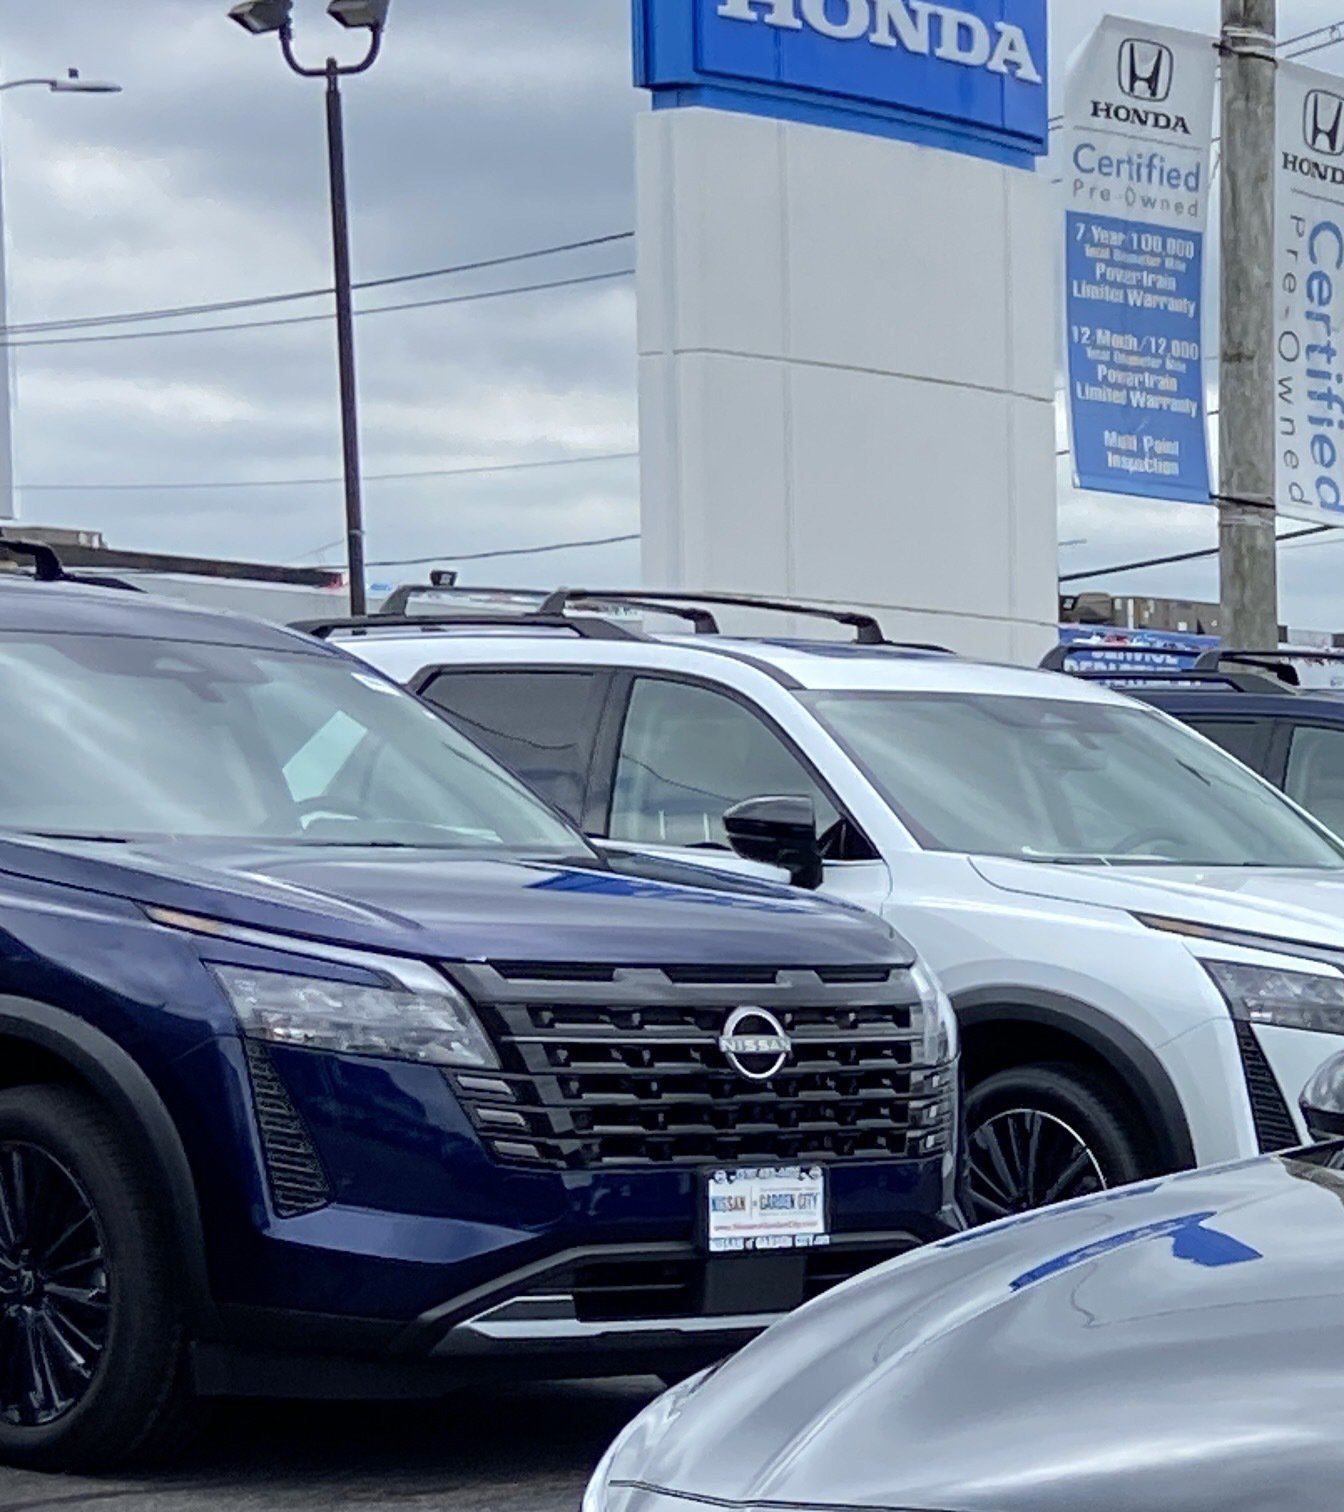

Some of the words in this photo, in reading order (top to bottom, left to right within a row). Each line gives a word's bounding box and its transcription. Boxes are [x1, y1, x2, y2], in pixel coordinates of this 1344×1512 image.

[1090, 100, 1191, 135] HONDA
[1073, 143, 1200, 193] Certified
[1127, 288, 1196, 318] Warranty
[1278, 214, 1313, 505] Pre-Owned
[1097, 364, 1178, 392] Powertrain
[1076, 381, 1127, 405] Limited
[1130, 390, 1198, 418] Warranty
[1106, 451, 1179, 476] Inspection
[720, 1038, 791, 1052] NISSAN
